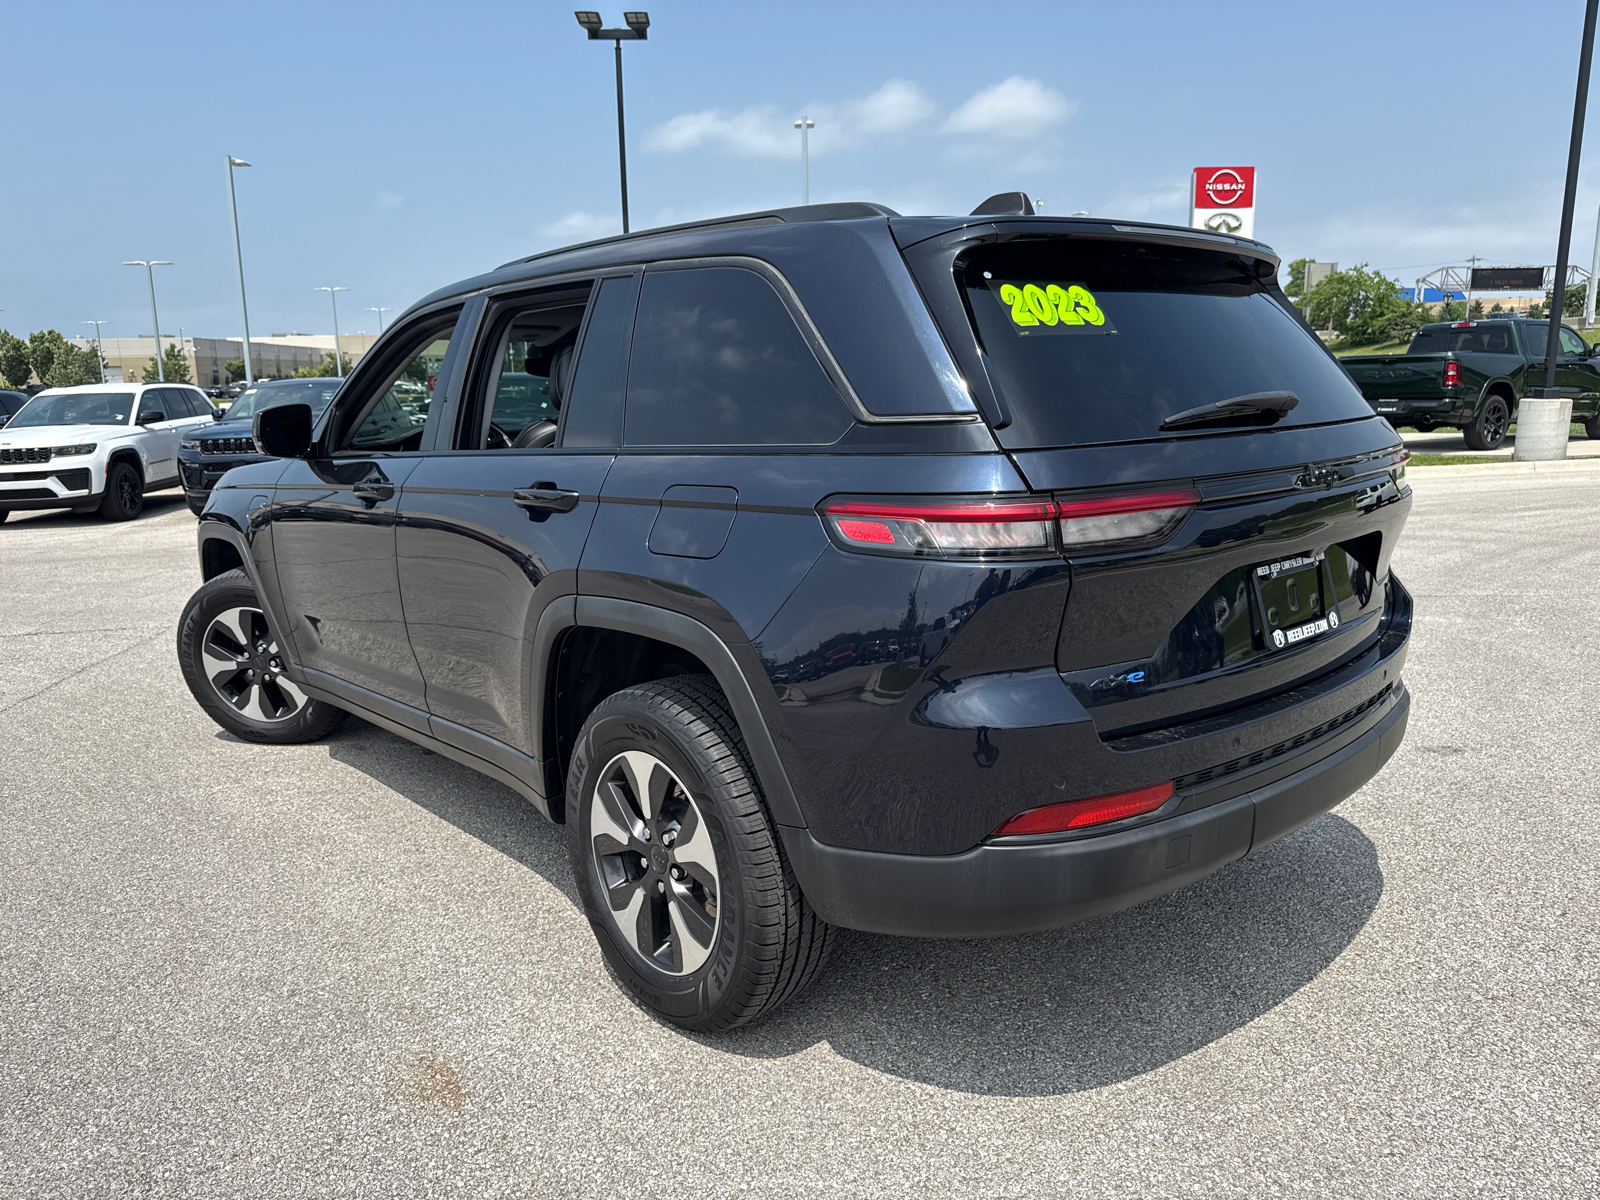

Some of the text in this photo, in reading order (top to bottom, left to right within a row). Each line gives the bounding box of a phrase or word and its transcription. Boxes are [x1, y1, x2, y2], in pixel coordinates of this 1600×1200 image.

[1205, 183, 1245, 191] NISSAN
[1000, 284, 1105, 326] 2023
[1363, 370, 1411, 379] RAM
[1256, 565, 1270, 576] REED
[1270, 562, 1281, 572] JEEP
[1281, 557, 1302, 570] CHRYSLER
[1286, 618, 1329, 643] REEDJEEP.COM
[1089, 671, 1146, 689] 4xe
[710, 829, 737, 991] ASSURANCE
